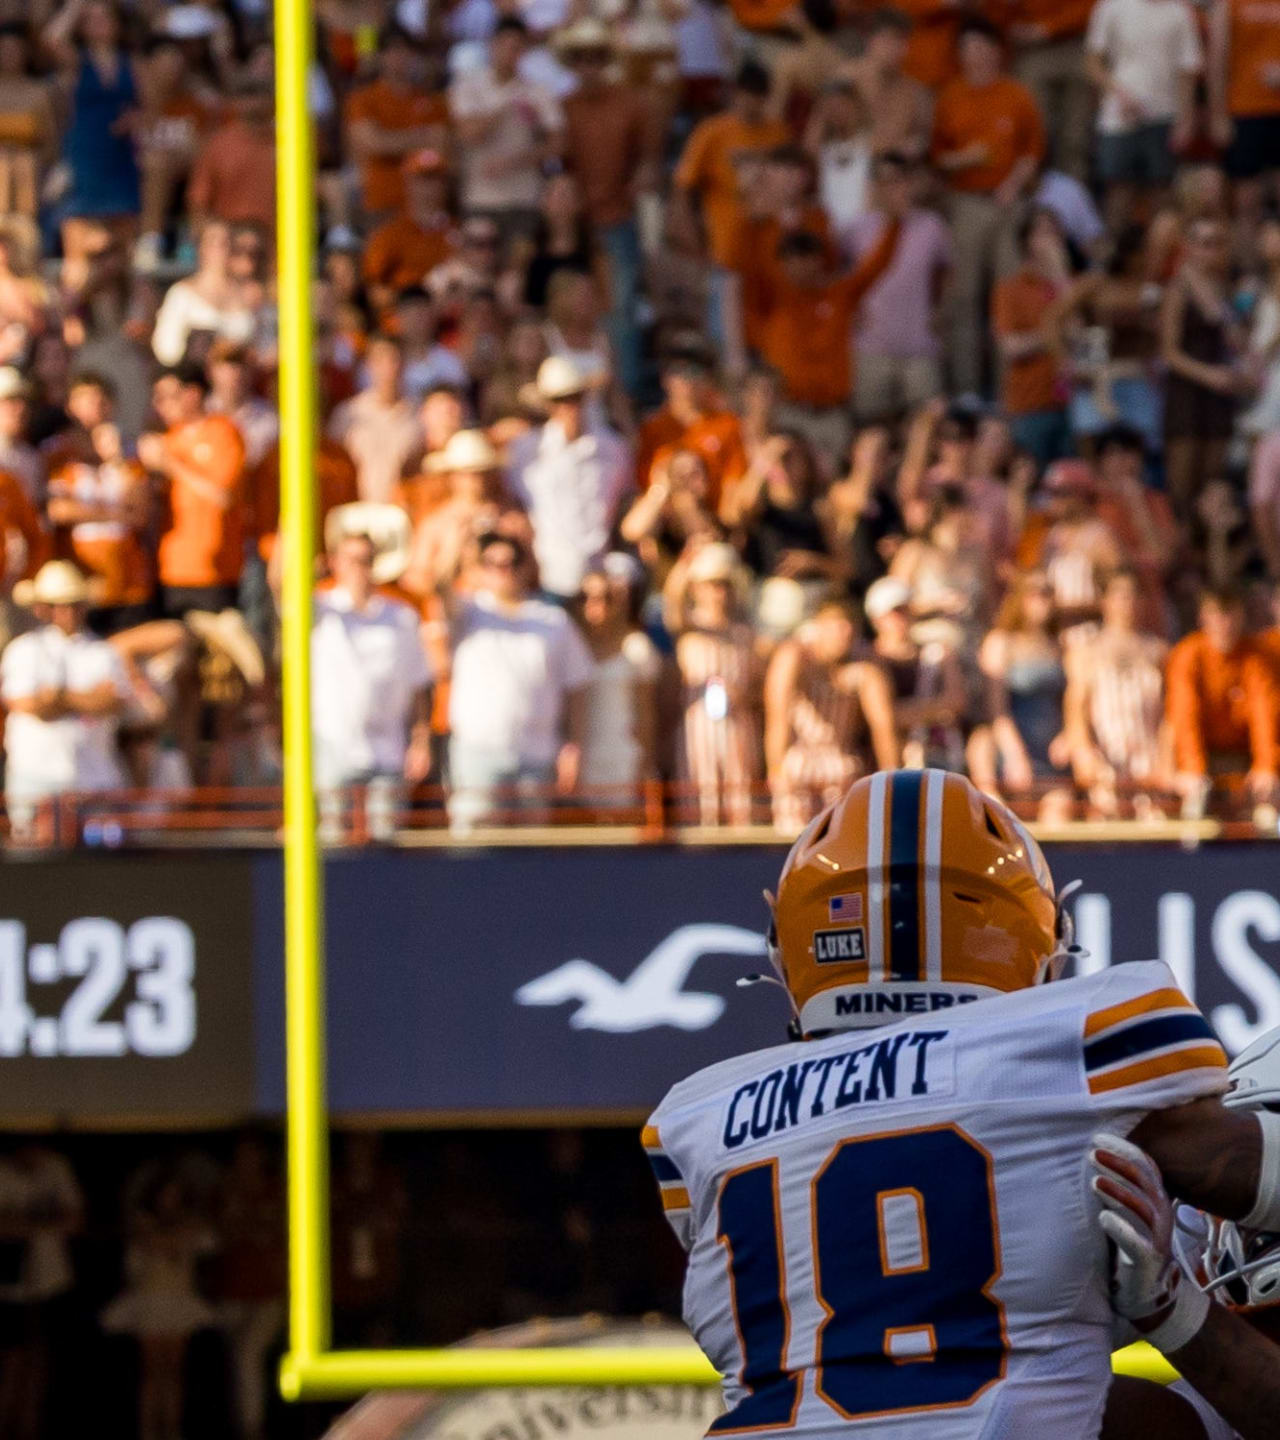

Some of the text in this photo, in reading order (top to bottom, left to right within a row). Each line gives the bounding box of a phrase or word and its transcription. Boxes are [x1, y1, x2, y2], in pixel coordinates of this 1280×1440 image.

[817, 933, 862, 960] LUKE
[723, 1031, 949, 1149] CONTENT
[704, 1121, 1012, 1438] 18
